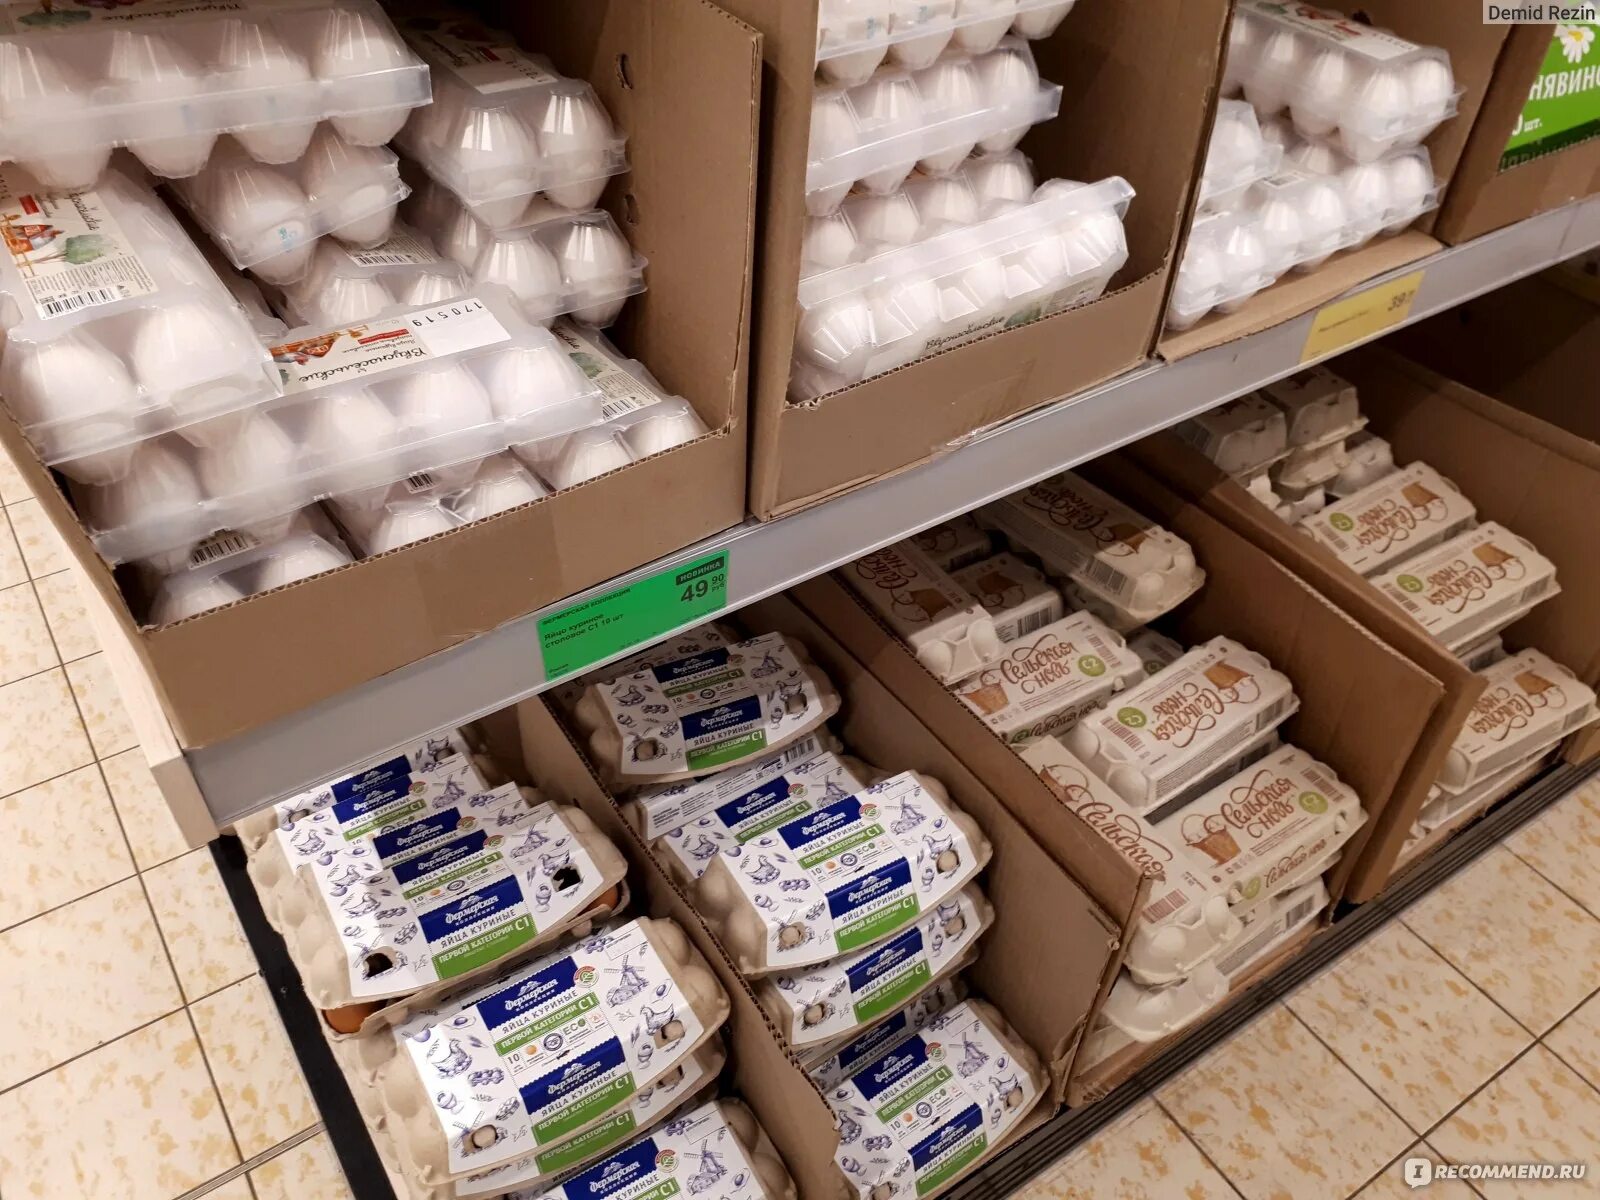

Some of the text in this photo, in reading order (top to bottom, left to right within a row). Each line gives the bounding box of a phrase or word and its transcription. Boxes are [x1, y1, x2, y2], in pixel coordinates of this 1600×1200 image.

[412, 301, 483, 328] 170519
[680, 561, 722, 582] НОВИНКА
[680, 579, 709, 602] 49
[544, 613, 604, 642] Яйцо куриное
[545, 629, 587, 649] столовое
[803, 822, 865, 853] ЯЙЦА КУРИНЫЕ
[803, 850, 829, 864] ПЕРВОЙ
[830, 832, 865, 851] КАТЕГОРИИ
[409, 879, 439, 895] ПЕРВОЙ
[441, 861, 482, 880] КАТЕГОРИИ
[412, 852, 485, 885] ЯЙЦА КУРИНЫЕ
[839, 921, 865, 937] ПЕРВОЙ
[866, 903, 901, 924] КАТЕГОРИИ
[842, 889, 904, 923] ЯЙЦА КУРИНЫЕ
[438, 919, 530, 963] ПЕРВОЙ КАТЕГОРИИ С1
[441, 910, 516, 948] ЯЙЦА КУРИНЫЕ
[500, 996, 594, 1048] ПЕРВОЙ КАТЕГОРИИ С1
[502, 991, 578, 1034] ЯЙЦА КУРИНЫЕ
[506, 1054, 520, 1064] 10
[541, 1070, 617, 1116] ЯЙЦА КУРИНЫЕ
[878, 1063, 933, 1103] ЯЙЦА КУРИНЫЕ
[882, 1098, 905, 1116] ПЕРВОЙ
[904, 1075, 935, 1100] КАТЕГОРИИ
[538, 1076, 629, 1131] ПЕРВОЙ КАТЕГОРИИ С1
[541, 1143, 572, 1160] ПЕРВОЙ
[573, 1121, 615, 1145] КАТЕГОРИИ
[614, 1174, 660, 1200] КУРИНЫЕ
[660, 1182, 675, 1195] С1
